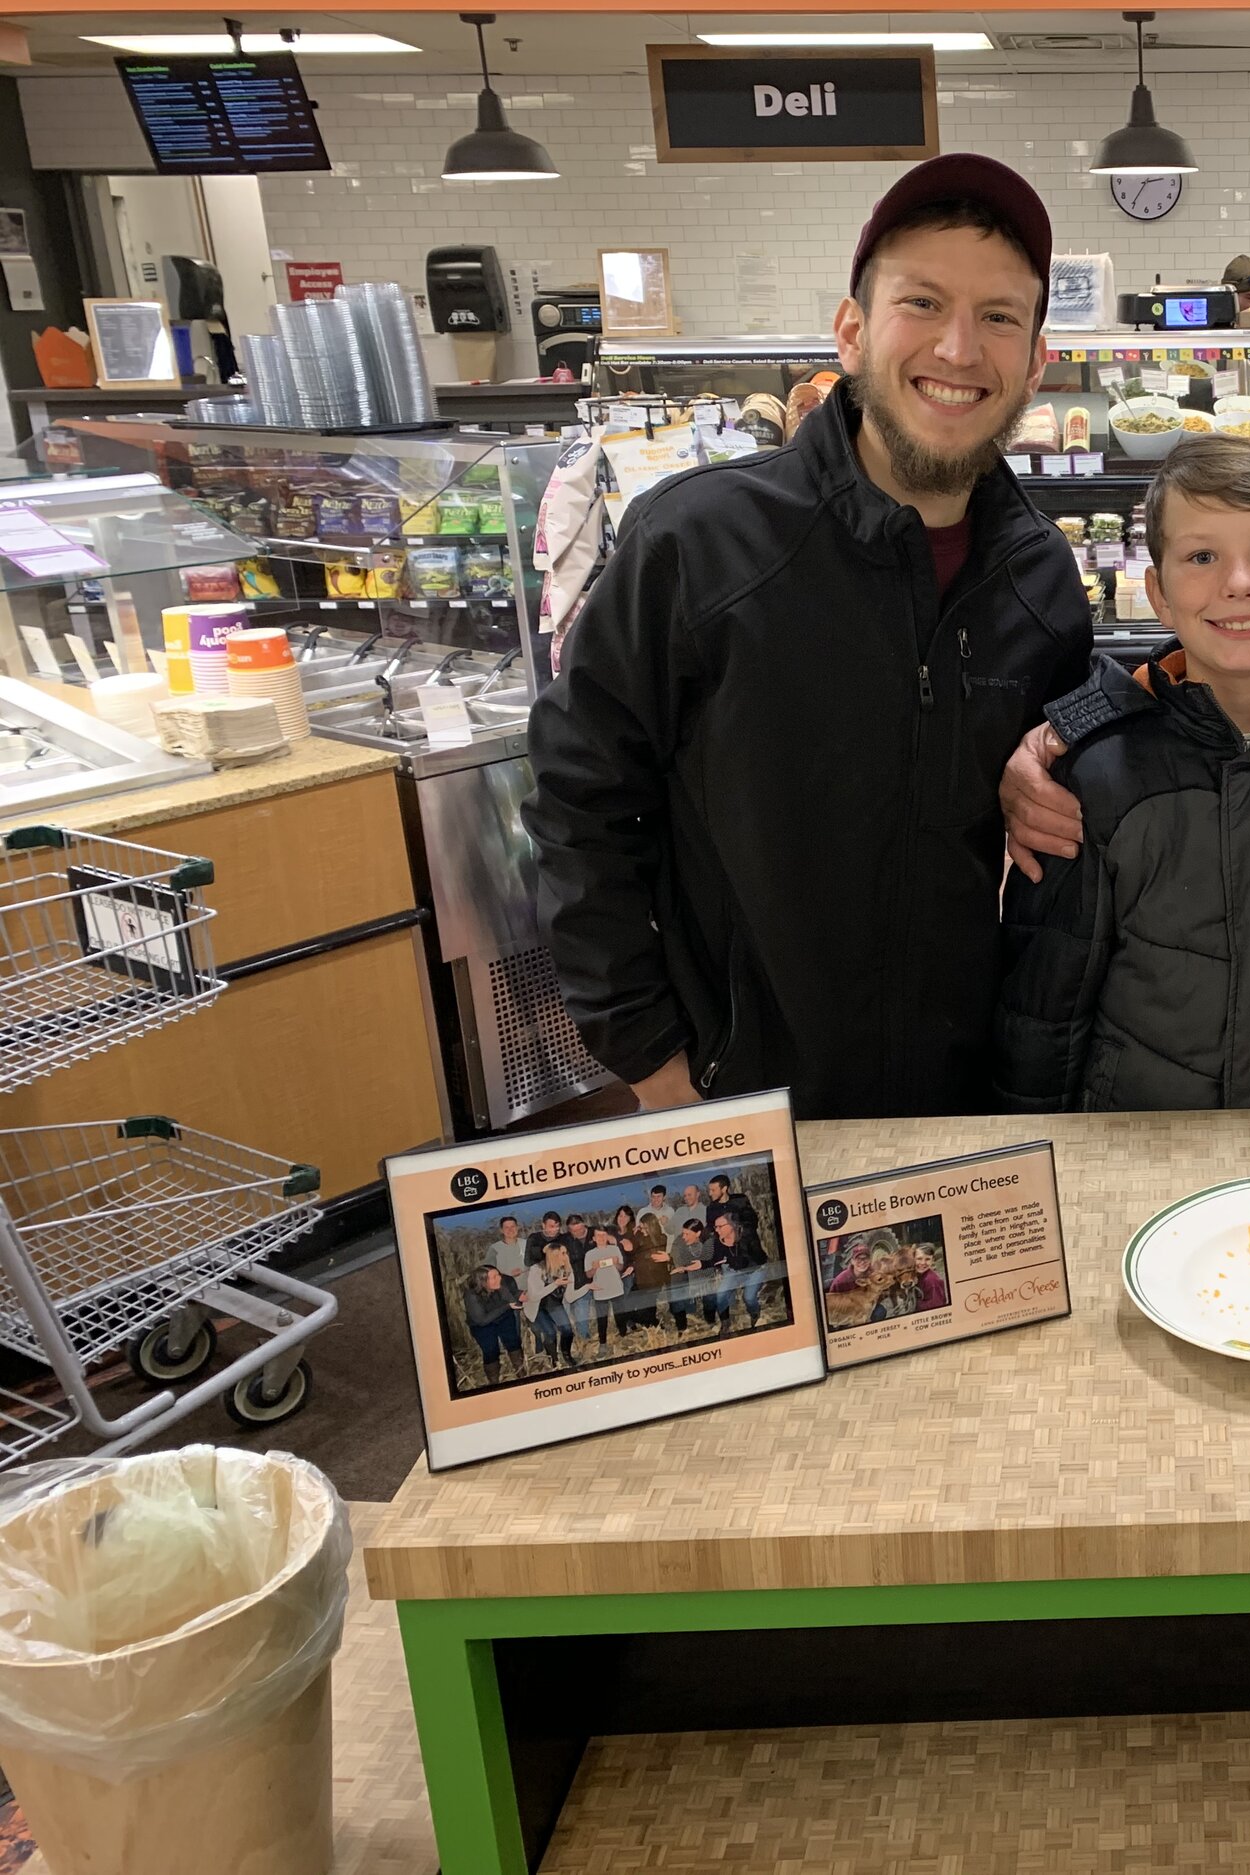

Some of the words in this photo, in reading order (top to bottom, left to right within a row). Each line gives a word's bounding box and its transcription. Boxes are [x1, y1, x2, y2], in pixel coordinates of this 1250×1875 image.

[754, 82, 837, 116] Deli
[289, 268, 339, 277] Employee
[493, 1165, 548, 1191] Little
[553, 1153, 621, 1180] Brown
[625, 1143, 669, 1167] Cow
[673, 1131, 745, 1158] Cheese
[457, 1174, 480, 1187] LBC
[849, 1198, 887, 1217] Little
[890, 1190, 936, 1208] Brown
[938, 1183, 968, 1198] Cow
[970, 1173, 1019, 1192] Cheese
[822, 1205, 841, 1216] LBC
[960, 1214, 974, 1223] This
[977, 1208, 1001, 1219] cheese
[1004, 1206, 1018, 1214] was
[1021, 1200, 1040, 1210] made
[960, 1222, 975, 1232] with
[978, 1219, 993, 1228] care
[993, 1215, 1009, 1225] from
[1026, 1208, 1043, 1218] small
[958, 1230, 978, 1241] family
[981, 1226, 996, 1236] farm
[999, 1224, 1006, 1232] in
[1009, 1218, 1040, 1232] Hingham,
[963, 1238, 981, 1249] place
[984, 1233, 1005, 1243] where
[1008, 1230, 1025, 1238] cows
[1028, 1225, 1044, 1234] have
[963, 1247, 986, 1257] names
[989, 1242, 1002, 1251] and
[1005, 1233, 1046, 1249] personalities
[968, 1255, 982, 1265] just
[985, 1252, 997, 1261] like
[1001, 1248, 1015, 1257] their
[1019, 1243, 1044, 1253] owners.
[964, 1284, 1018, 1313] Cheddar
[1019, 1273, 1060, 1302] Cheese
[878, 1323, 900, 1333] JERSEY
[911, 1316, 929, 1325] LITTLE
[931, 1311, 952, 1321] BROWN
[914, 1323, 929, 1331] COW
[930, 1317, 952, 1327] CHEESE
[829, 1333, 856, 1344] ORGANIC
[837, 1341, 851, 1349] MILK
[877, 1332, 891, 1340] MILK
[534, 1385, 563, 1400] from
[565, 1378, 586, 1393] our
[588, 1370, 624, 1389] family
[627, 1366, 641, 1380] to
